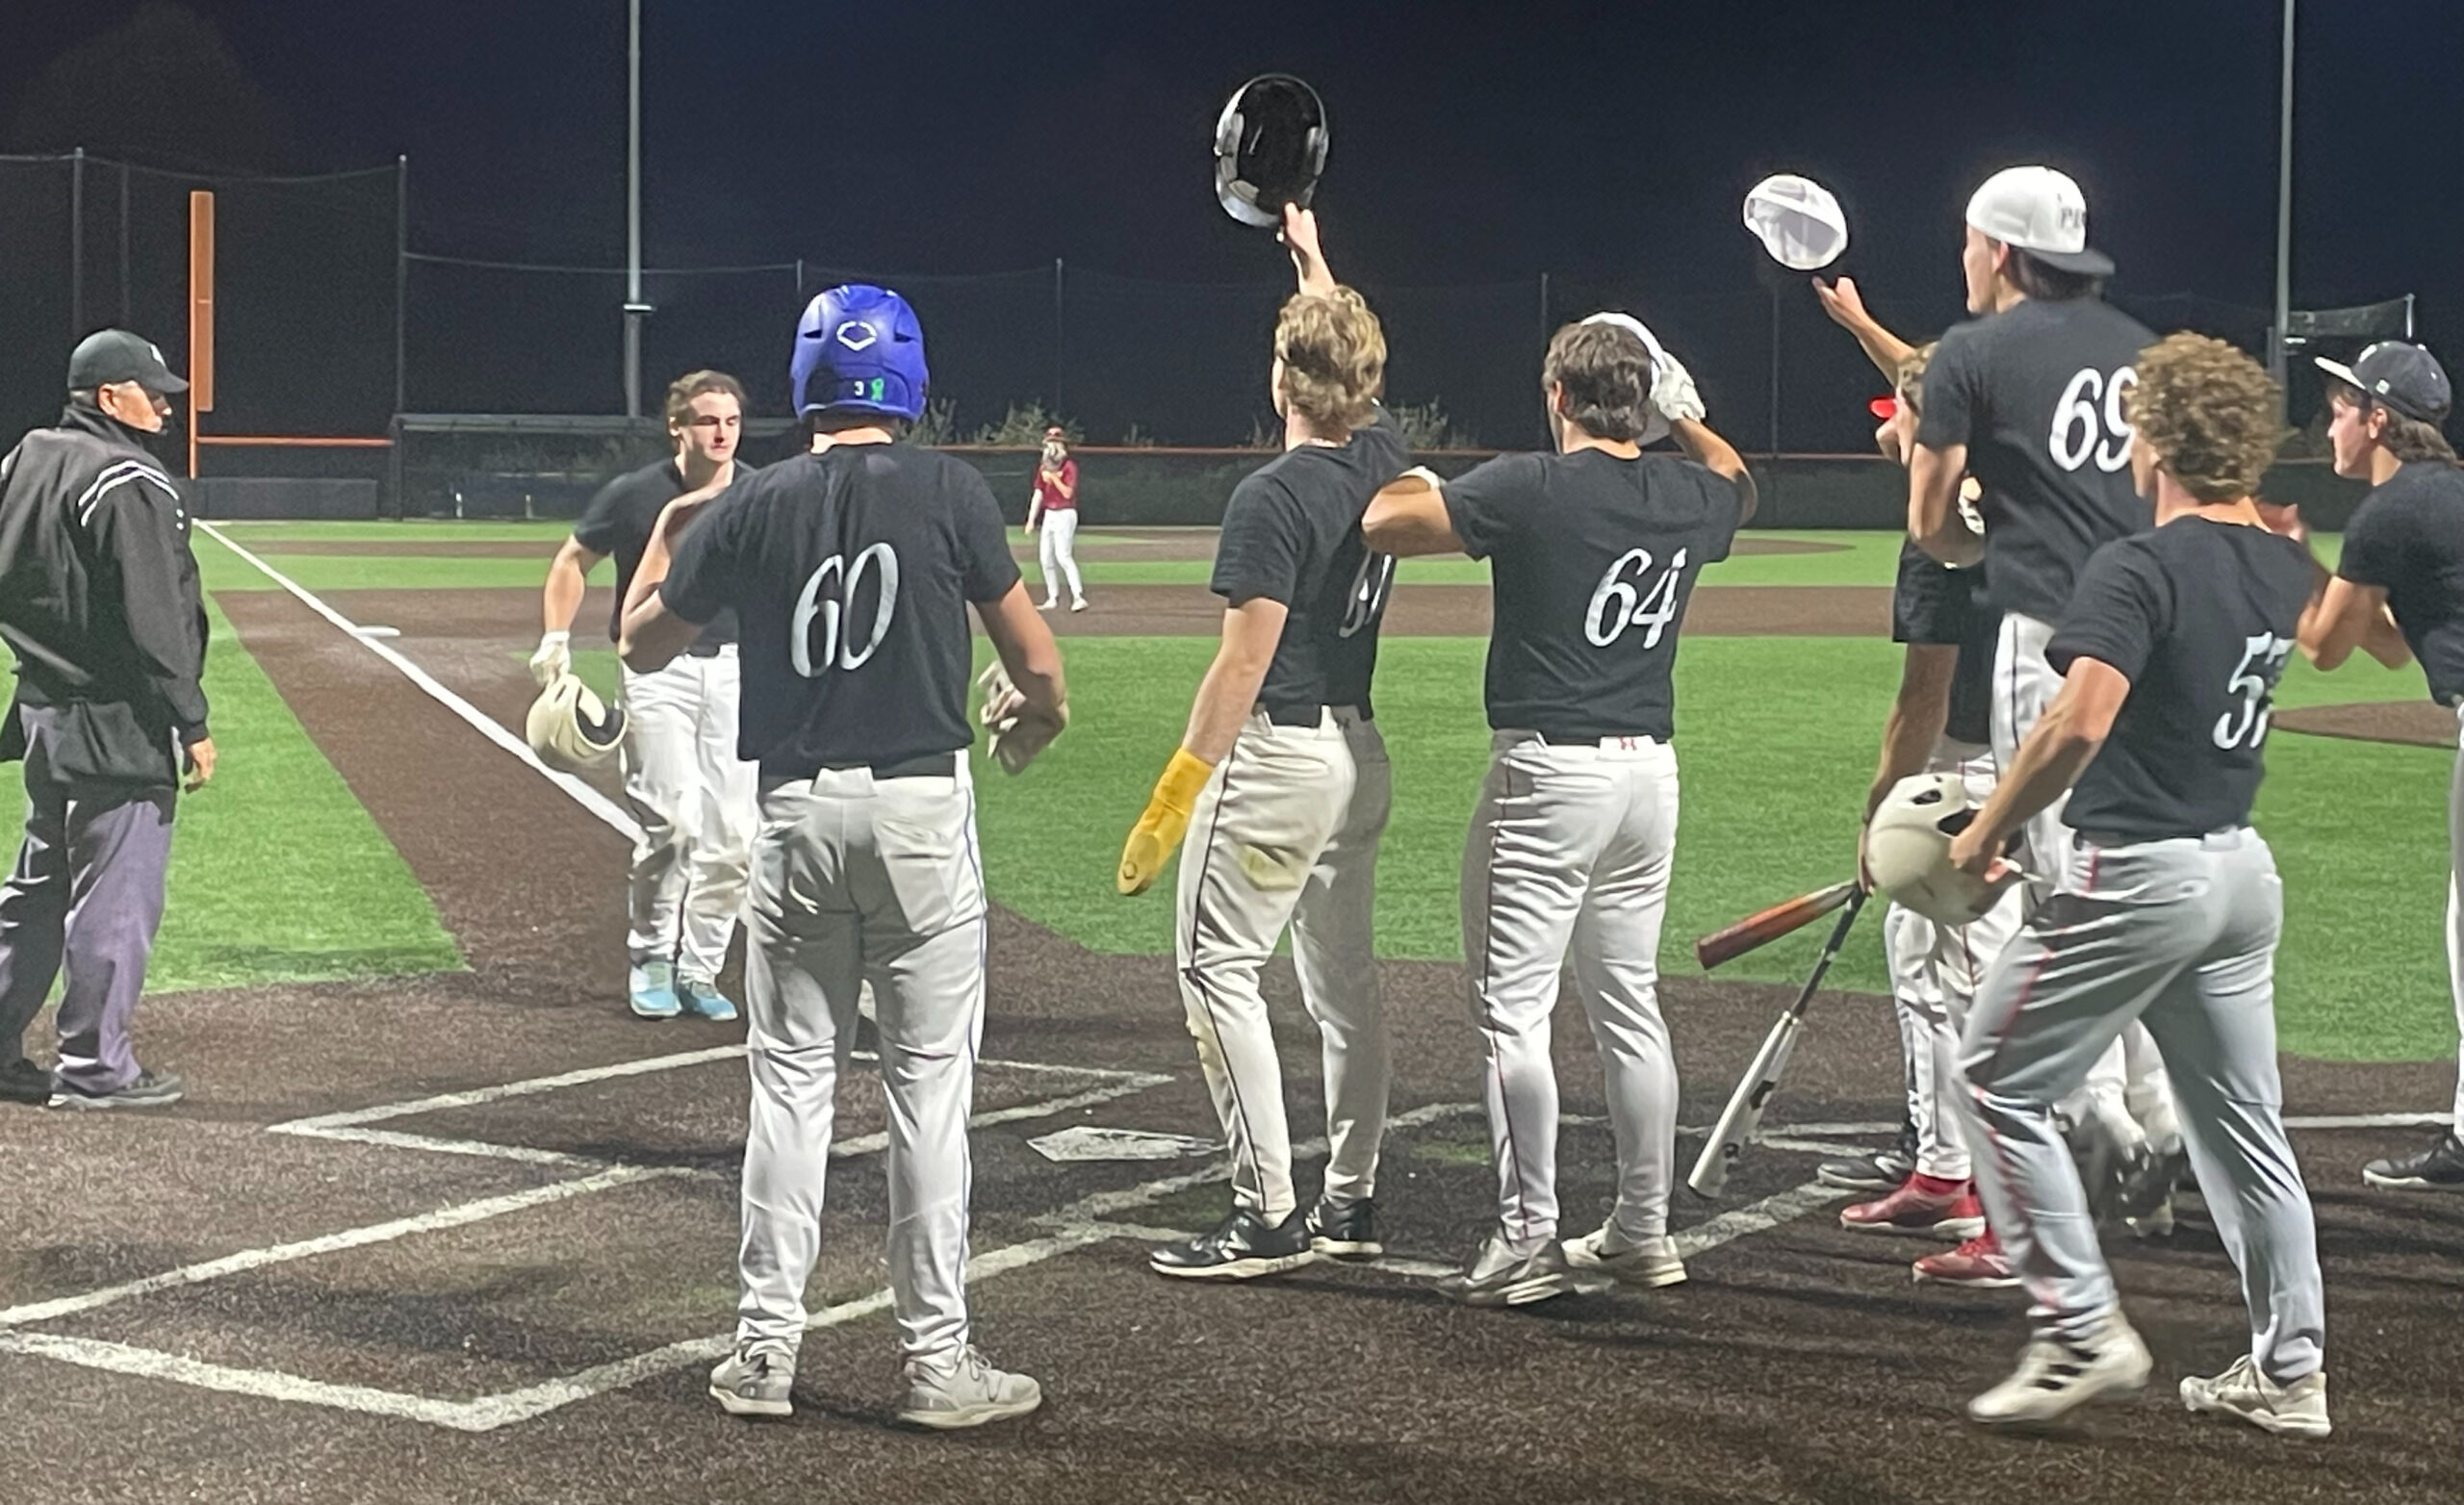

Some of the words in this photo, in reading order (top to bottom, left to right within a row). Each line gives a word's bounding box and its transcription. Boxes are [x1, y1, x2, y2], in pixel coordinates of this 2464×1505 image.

[2048, 366, 2140, 472] 69
[791, 542, 899, 677] 60
[1584, 547, 1687, 650] 64
